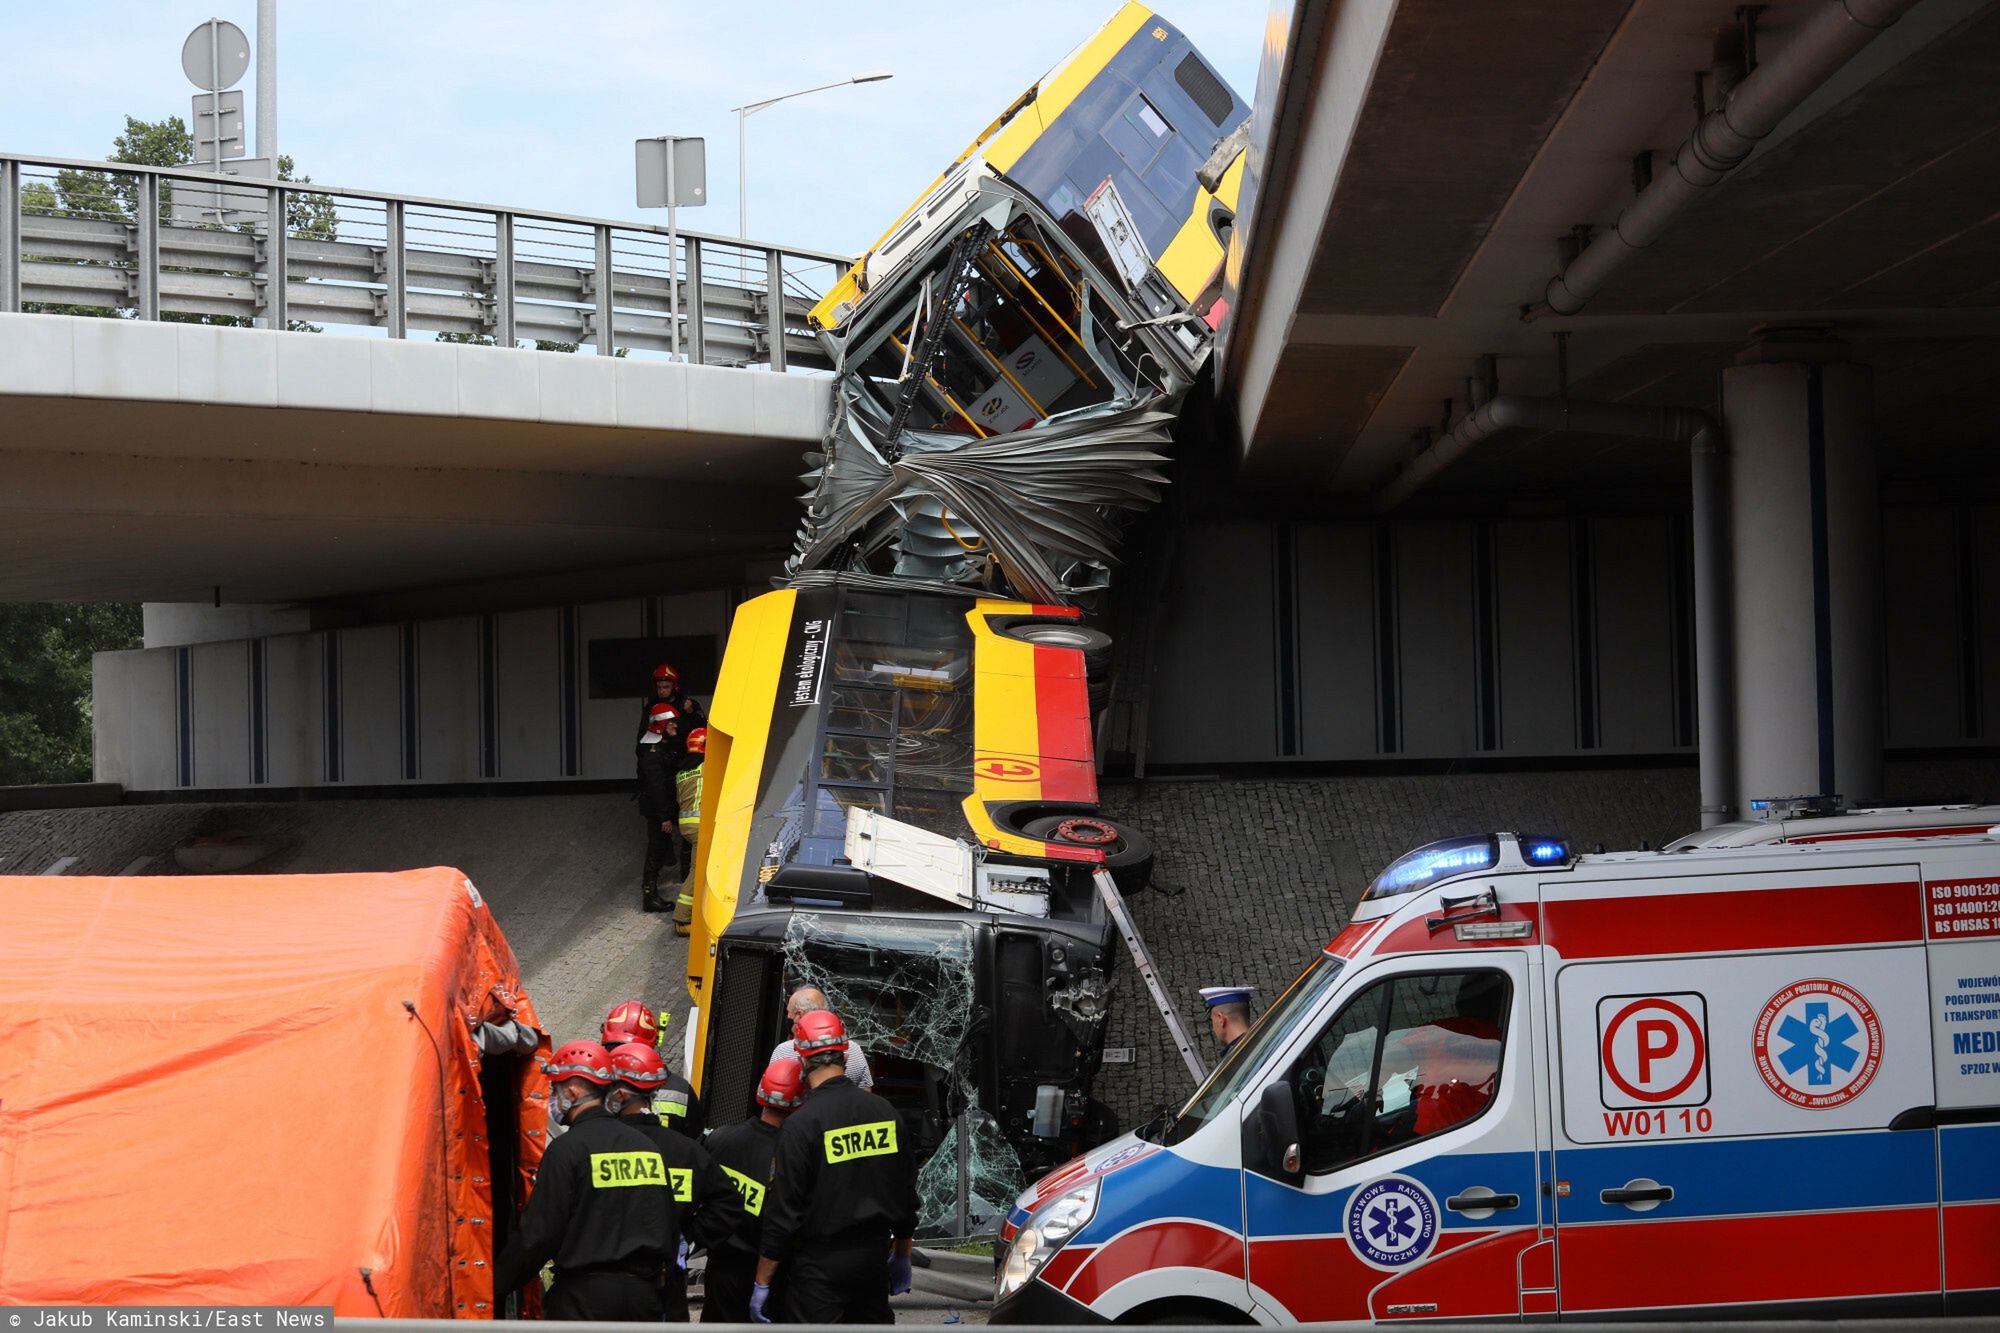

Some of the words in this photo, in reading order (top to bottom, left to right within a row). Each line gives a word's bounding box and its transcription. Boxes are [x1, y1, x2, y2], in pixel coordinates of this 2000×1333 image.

[803, 620, 823, 634] CNG
[795, 640, 824, 679] ekologiczny
[789, 679, 814, 704] jestem
[1932, 886, 1951, 898] ISO
[1954, 883, 2000, 897] 9001:20
[1934, 903, 1953, 915] ISO
[1935, 920, 1951, 932] BS
[1953, 918, 1990, 931] OHSAS
[1958, 975, 2000, 988] WOJEWÓ
[1945, 993, 2000, 1006] POGOTOWIA
[1757, 1007, 1775, 1047] WOJEWÓDZKA
[1773, 991, 1794, 1008] STACJA
[1794, 983, 1829, 994] POGOTOWIA
[1637, 1019, 1679, 1083] P
[1961, 1063, 1991, 1075] SPZOZ
[1603, 1110, 1666, 1136] W01
[1679, 1108, 1713, 1133] 10
[1352, 1185, 1386, 1240] PAŃSTWOWE
[1397, 1184, 1433, 1238] RATOWNICTWO
[1367, 1246, 1419, 1261] MEDYCZNE
